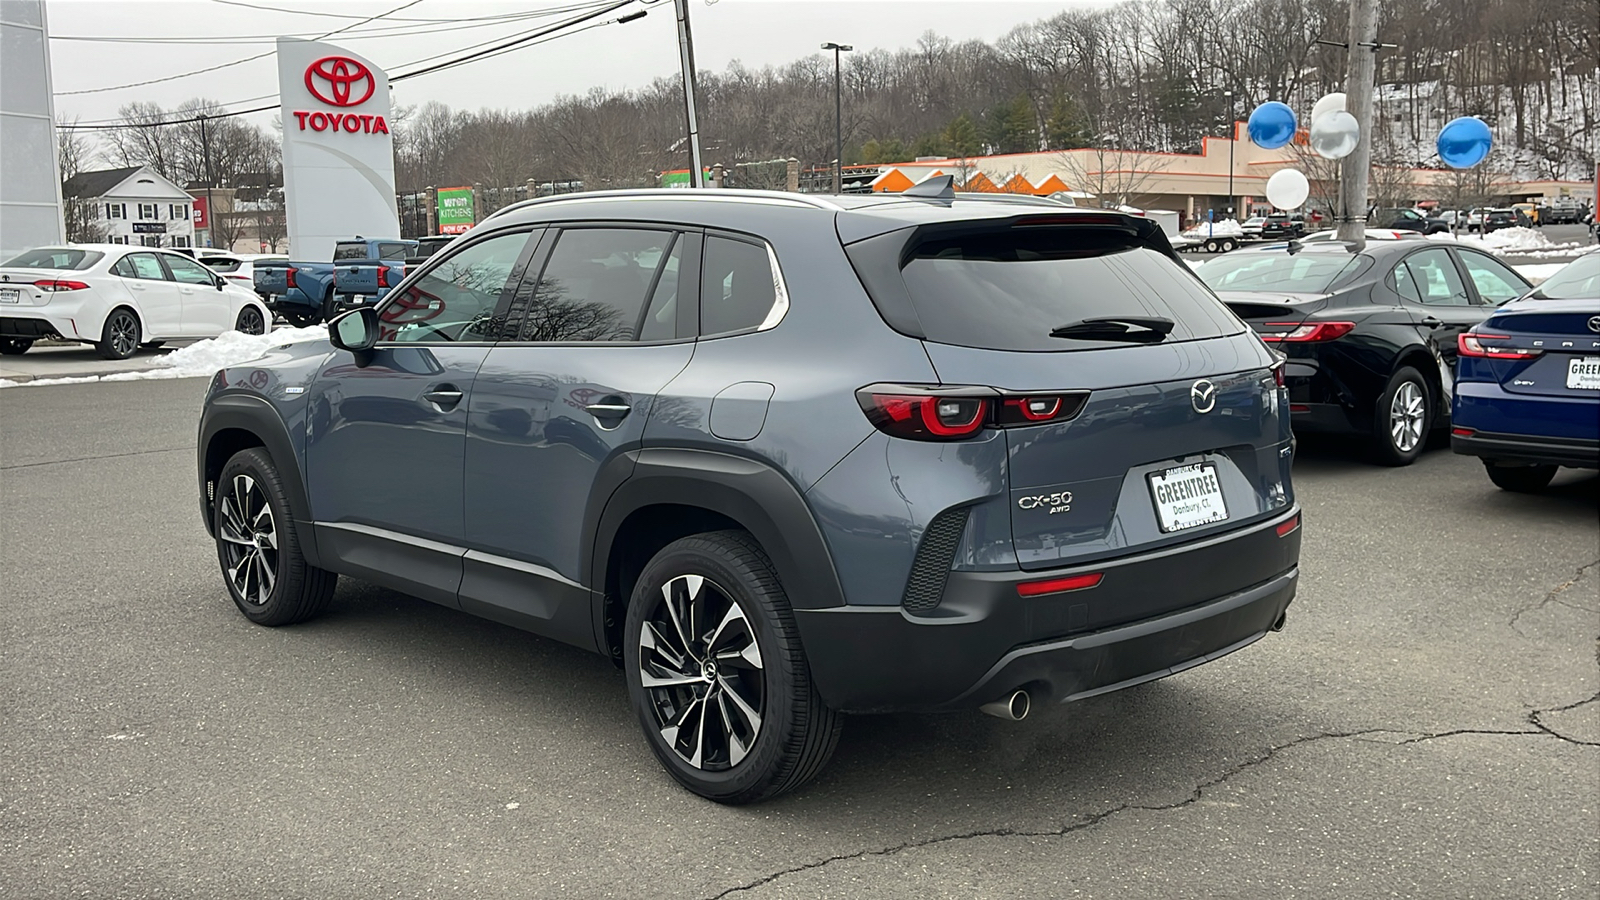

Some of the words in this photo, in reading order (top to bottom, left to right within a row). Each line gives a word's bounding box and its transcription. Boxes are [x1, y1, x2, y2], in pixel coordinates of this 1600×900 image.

[293, 111, 389, 134] TOYOTA
[440, 208, 472, 218] KITCHENS
[443, 225, 456, 233] NOW
[1157, 474, 1218, 505] GREENTREE
[1018, 491, 1073, 509] CX-50
[1049, 505, 1070, 515] AWD
[1172, 502, 1202, 516] Danbury,
